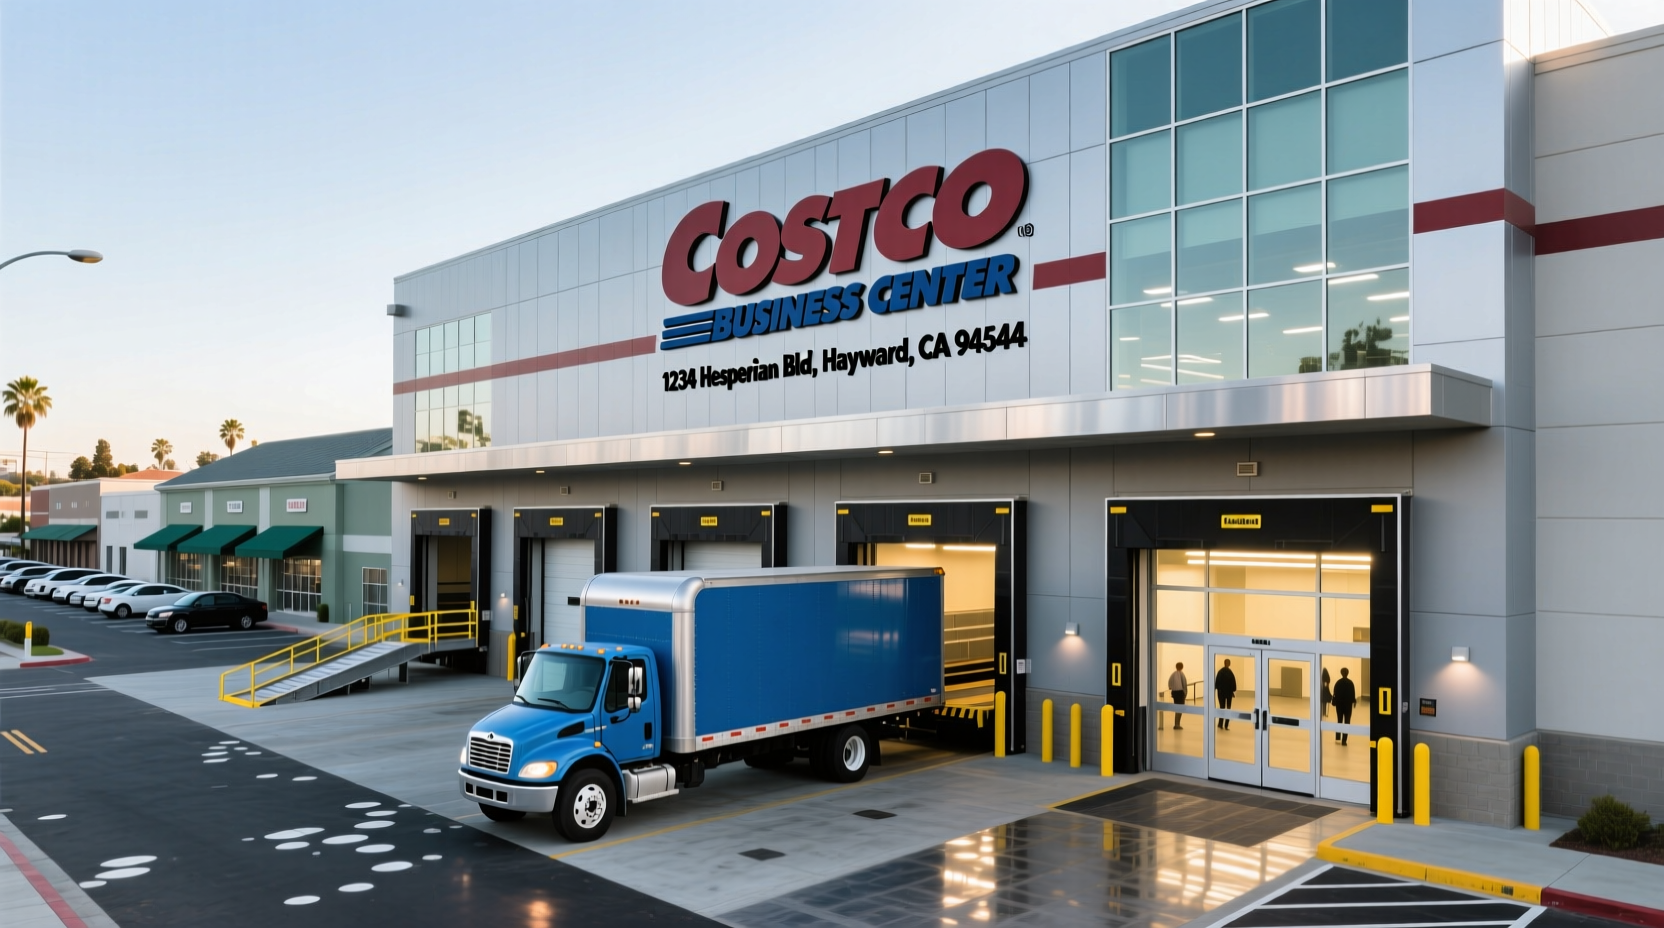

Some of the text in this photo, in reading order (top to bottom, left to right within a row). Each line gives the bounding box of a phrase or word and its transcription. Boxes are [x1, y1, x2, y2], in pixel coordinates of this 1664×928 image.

[661, 148, 1030, 307] COSTCO
[711, 253, 1021, 342] BUSINESS CENTER
[662, 367, 698, 392] 1234
[699, 358, 780, 391] Hesperian
[822, 337, 915, 376] Hayward,
[918, 332, 951, 360] CA
[954, 321, 1028, 354] 94544
